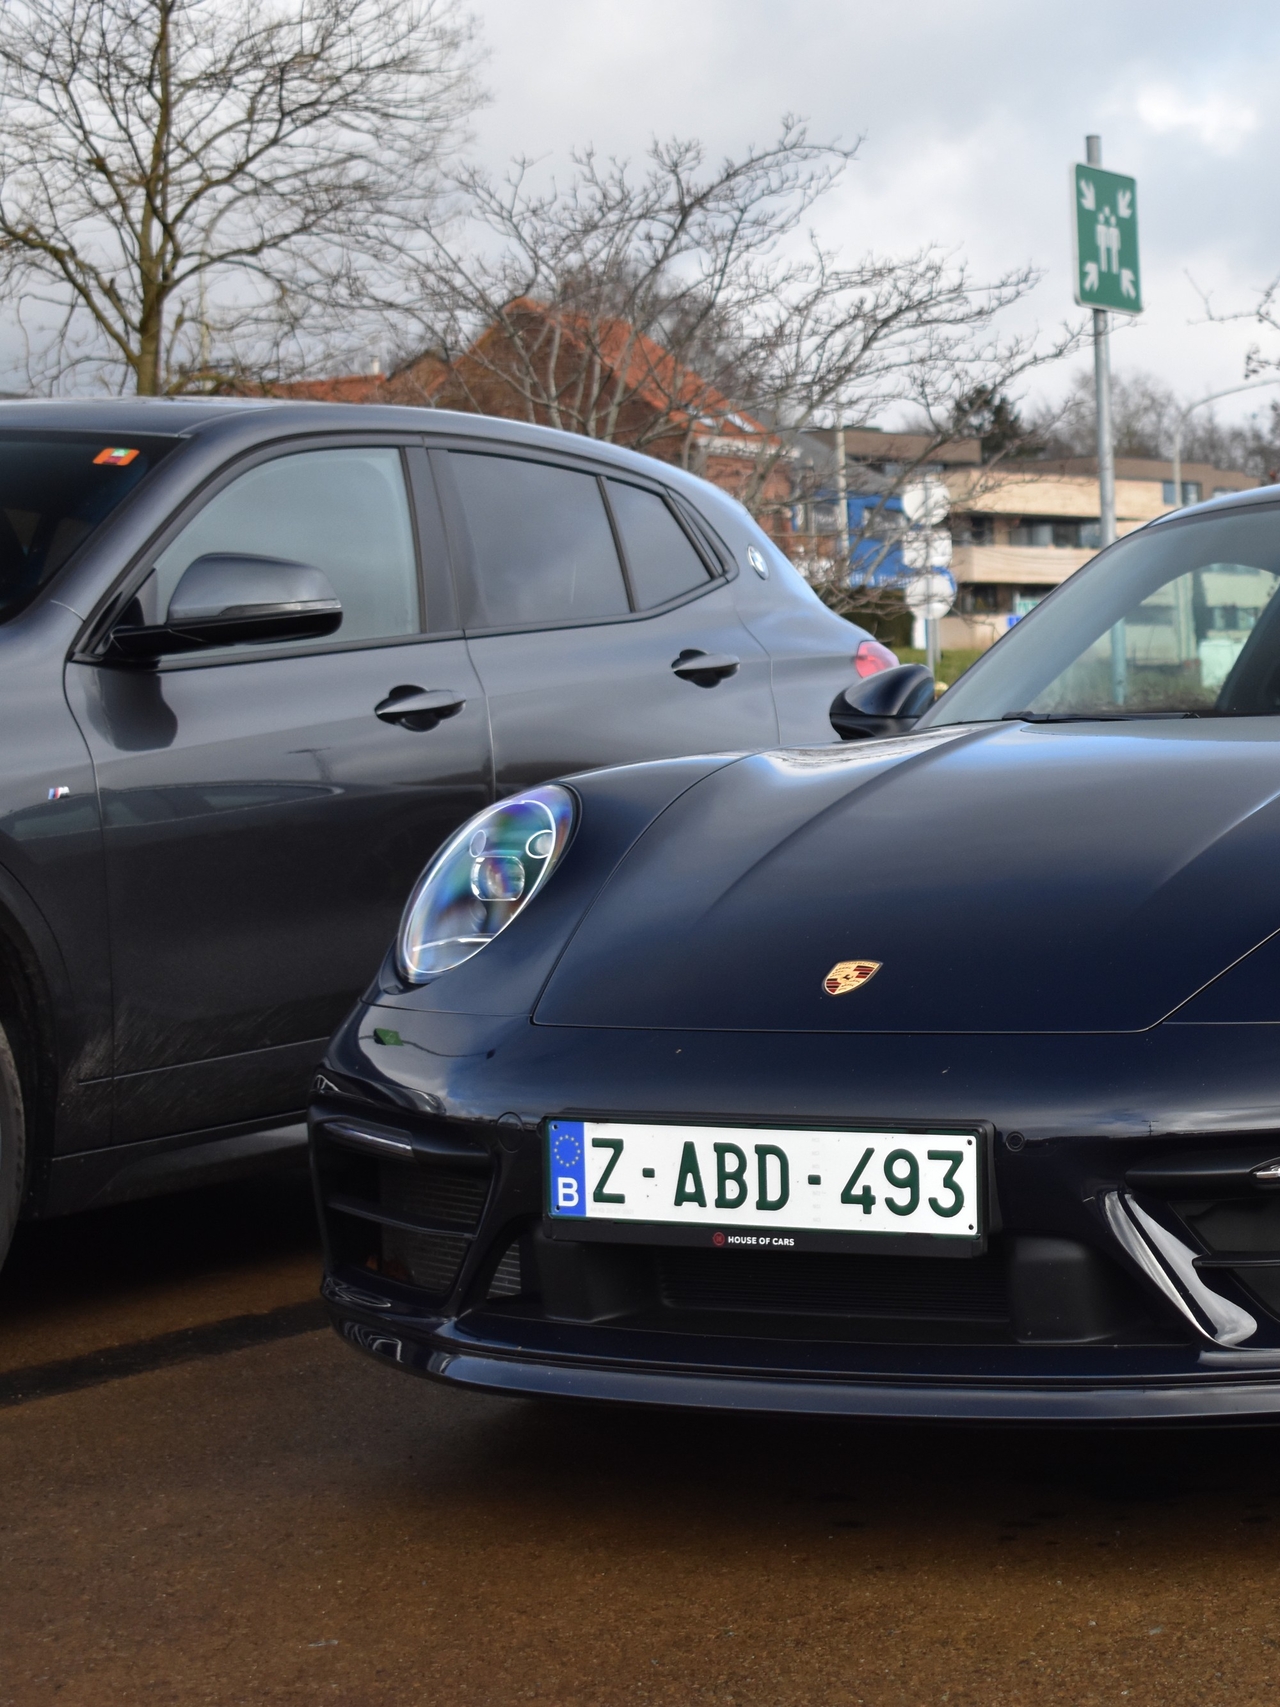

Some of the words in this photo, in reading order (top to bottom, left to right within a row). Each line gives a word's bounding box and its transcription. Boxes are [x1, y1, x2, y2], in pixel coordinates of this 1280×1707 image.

[557, 1177, 580, 1207] B
[728, 1236, 758, 1245] HOUSE
[759, 1237, 771, 1245] OF
[772, 1238, 795, 1246] CARS
